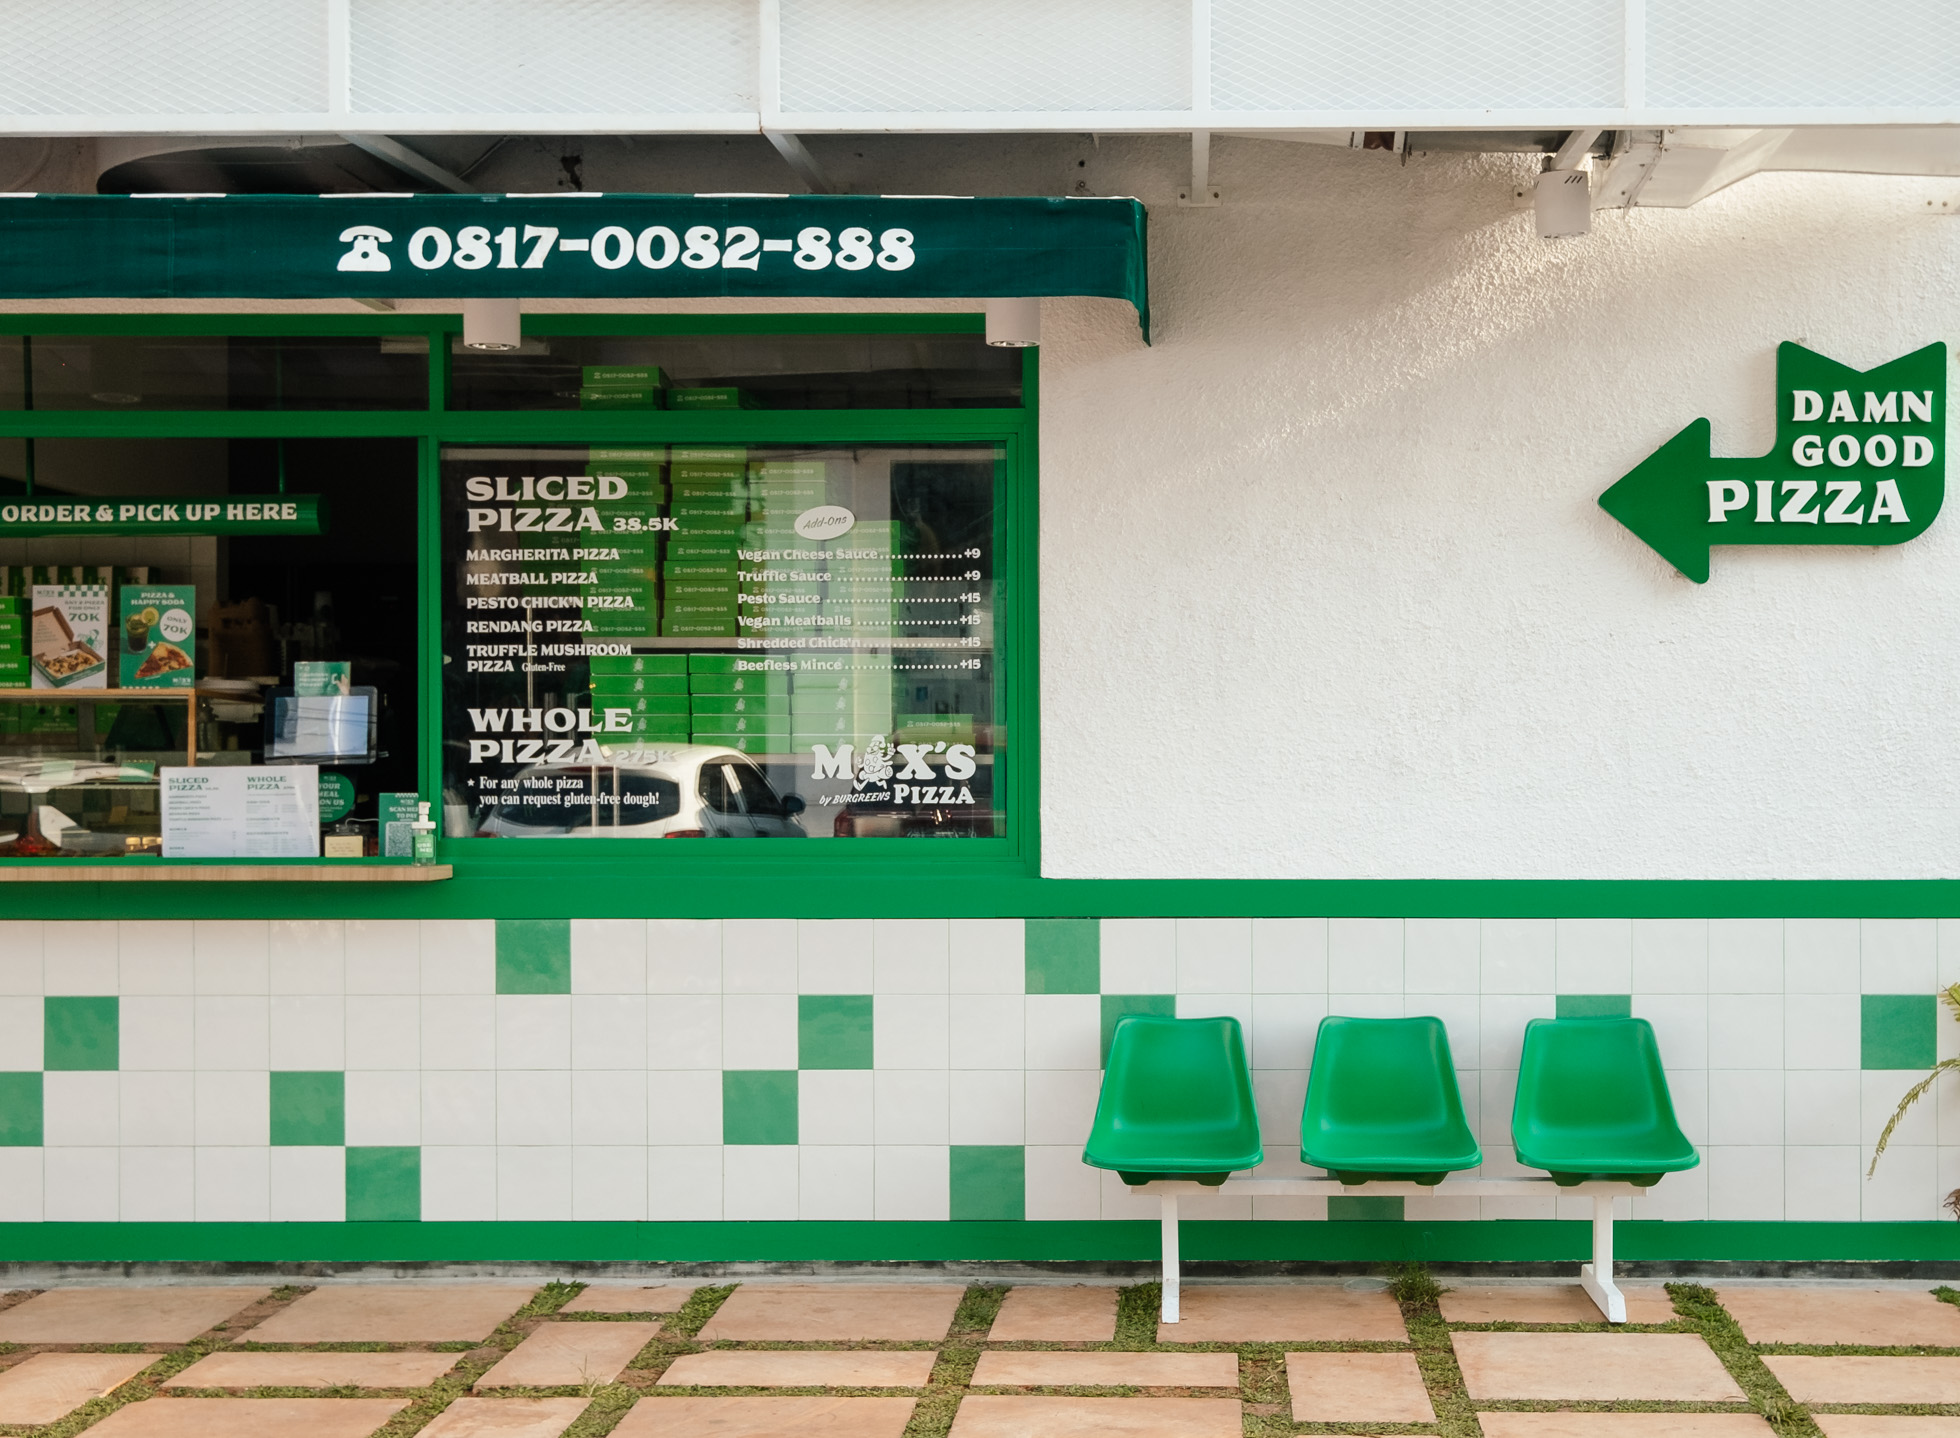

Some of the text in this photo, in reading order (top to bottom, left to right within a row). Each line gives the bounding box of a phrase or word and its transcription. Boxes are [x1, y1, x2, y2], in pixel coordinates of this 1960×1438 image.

[408, 225, 915, 272] 0817-0082-888
[1792, 390, 1933, 423] DAMN
[1792, 434, 1934, 468] GOOD
[466, 476, 629, 501] SLICED
[1706, 479, 1911, 525] PIZZA
[2, 503, 297, 522] ORDER & PICK UP HERE
[467, 507, 679, 532] PIZZA 38.5K
[802, 515, 848, 530] Add-Ons
[466, 547, 620, 562] MARGHERITA PIZZA
[737, 549, 781, 562] Vegan
[783, 549, 834, 560] Cheese
[836, 549, 878, 559] Sauce
[964, 548, 981, 559] +9
[466, 571, 598, 585] MEATBALL PIZZA
[737, 570, 981, 582] Truffle Sauce +9
[466, 595, 634, 609] PESTO CHICK'N PIZZA
[737, 592, 981, 604] Pesto Sauce +15
[69, 613, 100, 622] 70K
[166, 616, 187, 624] ONLY
[737, 614, 981, 629] Vegan Meatballs +15
[163, 624, 188, 635] 70K
[466, 620, 594, 633] RENDANG PIZZA
[466, 643, 632, 657] TRUFFLE MUSHROOM
[737, 636, 981, 649] Shredded Chick'n +15
[467, 660, 566, 672] PIZZA Gluten-Free
[737, 659, 981, 671] Beefless Mince +15
[467, 707, 633, 732] WHOLE
[468, 738, 605, 764] PIZZA
[811, 740, 976, 780] MX'S
[479, 776, 584, 791] For any whole pizza
[479, 792, 660, 808] you can request gluten-free dough!
[819, 791, 890, 807] by BURGREENS
[893, 784, 975, 805] PIZZA
